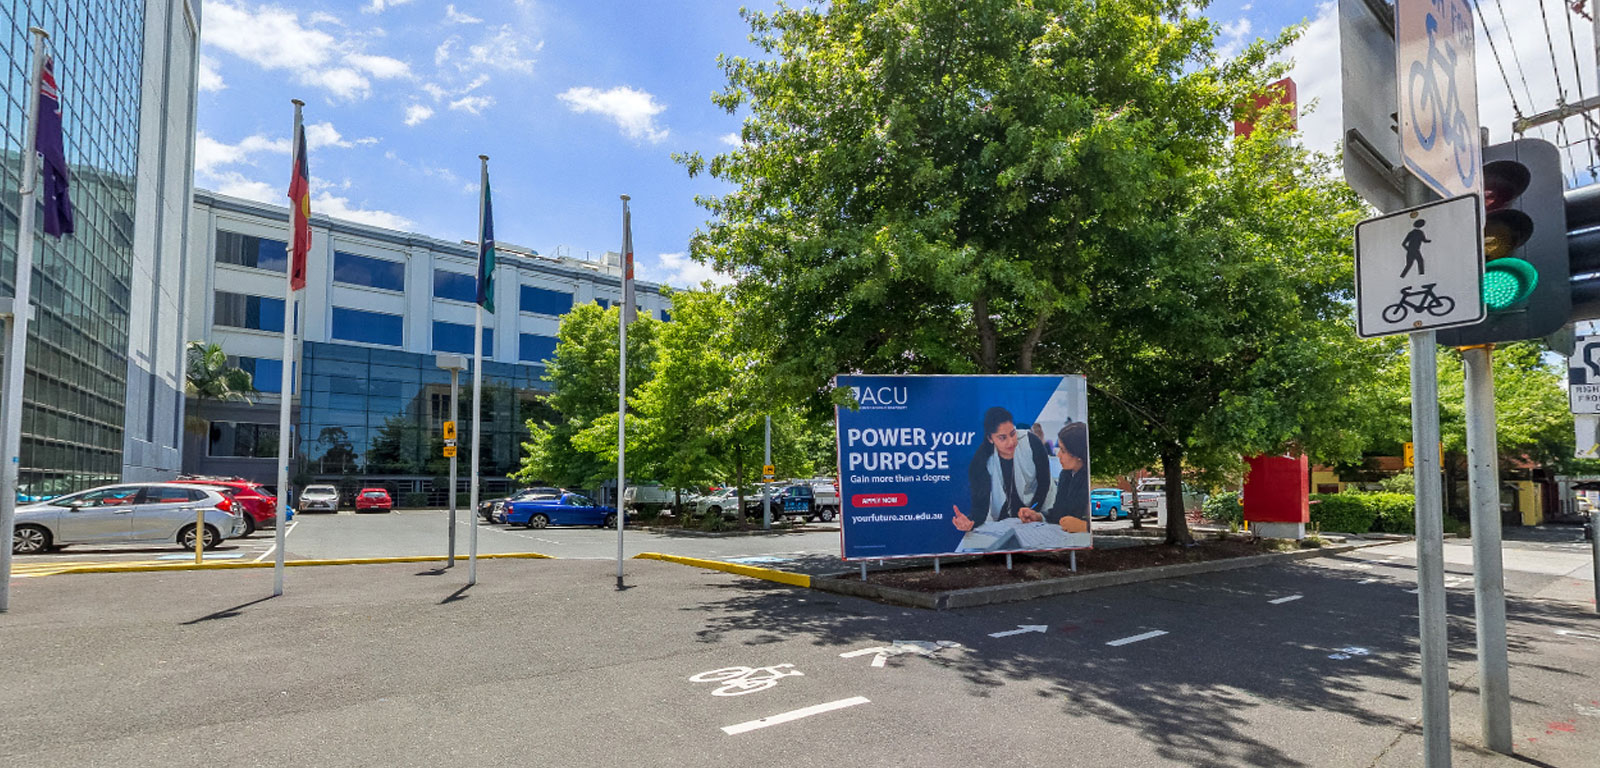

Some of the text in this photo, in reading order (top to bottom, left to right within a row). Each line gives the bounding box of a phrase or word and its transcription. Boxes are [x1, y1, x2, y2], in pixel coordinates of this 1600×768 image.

[861, 386, 908, 405] ACU
[1576, 385, 1600, 393] RIGH
[1578, 394, 1600, 402] FRO
[848, 428, 975, 450] POWER your
[849, 451, 949, 471] PURPOSE
[850, 474, 870, 483] Gain
[872, 475, 894, 483] more
[895, 474, 914, 482] than
[922, 473, 950, 483] degree
[852, 512, 943, 525] yourfuture.acu.edu.au
